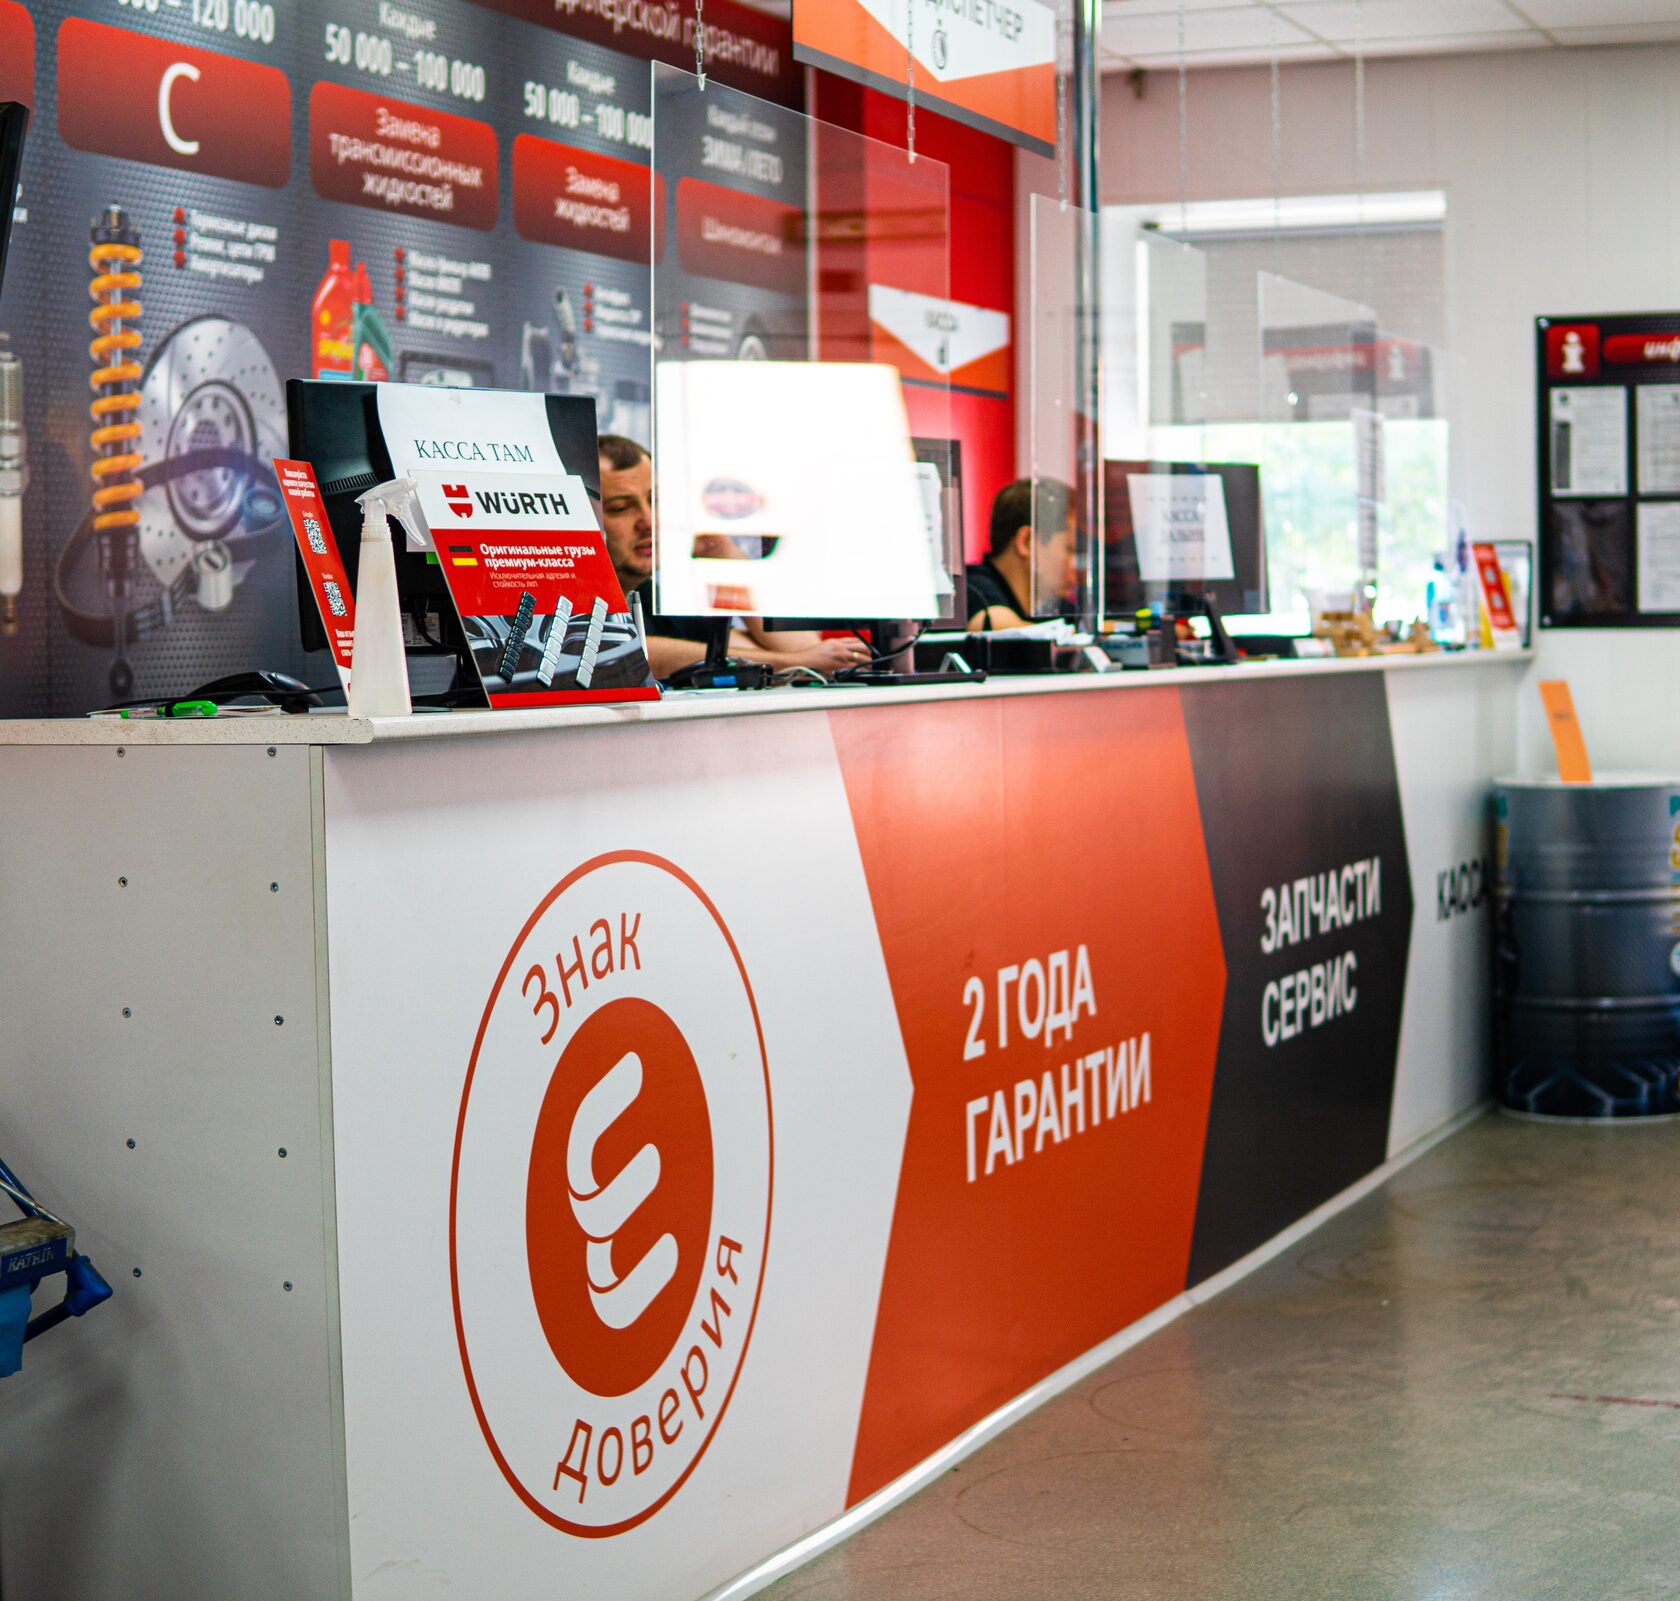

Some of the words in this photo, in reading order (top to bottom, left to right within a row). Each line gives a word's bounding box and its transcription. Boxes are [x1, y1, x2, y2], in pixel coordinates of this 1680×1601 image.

[234, 0, 275, 45] 000
[325, 22, 351, 65] 50
[355, 31, 392, 77] 000
[413, 50, 448, 93] 100
[451, 59, 485, 103] 000
[524, 81, 547, 118] 50
[549, 88, 580, 129] 000
[596, 103, 625, 142] 100
[414, 439, 487, 461] КАССА
[486, 443, 535, 463] ТАМ
[475, 491, 570, 516] WÜRTH
[479, 543, 563, 558] Оригинальные
[563, 545, 596, 559] грузы
[484, 557, 575, 571] премиум-класса
[1260, 855, 1382, 955] ЗАПЧАСТИ
[962, 976, 986, 1061] 2
[997, 944, 1097, 1049] ГОДА
[1262, 950, 1357, 1047] СЕРВИС
[965, 1031, 1151, 1183] ГАРАНТИИ
